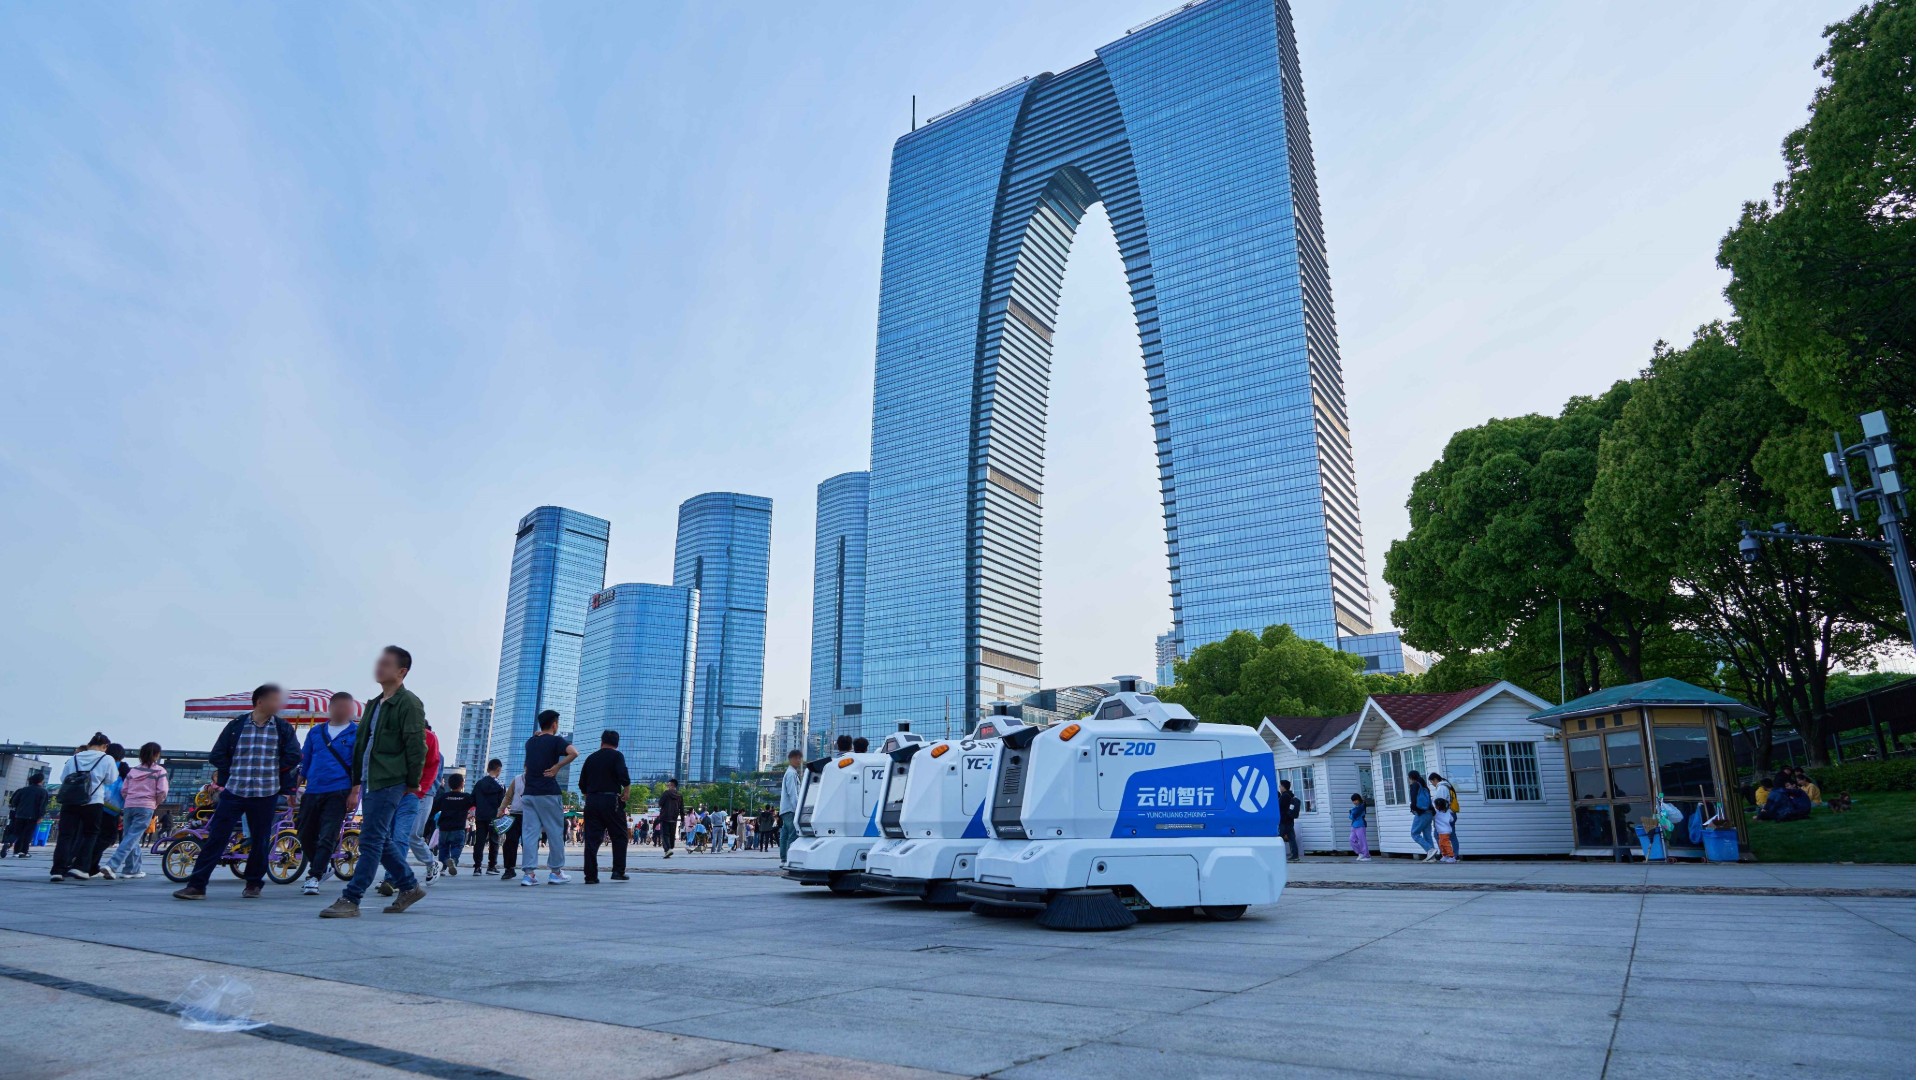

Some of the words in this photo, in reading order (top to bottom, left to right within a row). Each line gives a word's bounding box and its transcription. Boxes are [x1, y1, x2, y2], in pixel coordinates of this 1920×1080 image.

[1100, 742, 1156, 756] YC-200
[1137, 786, 1215, 807] 云创智行
[1146, 811, 1183, 819] YUNCHUANG
[1183, 811, 1207, 819] ZHIXING
